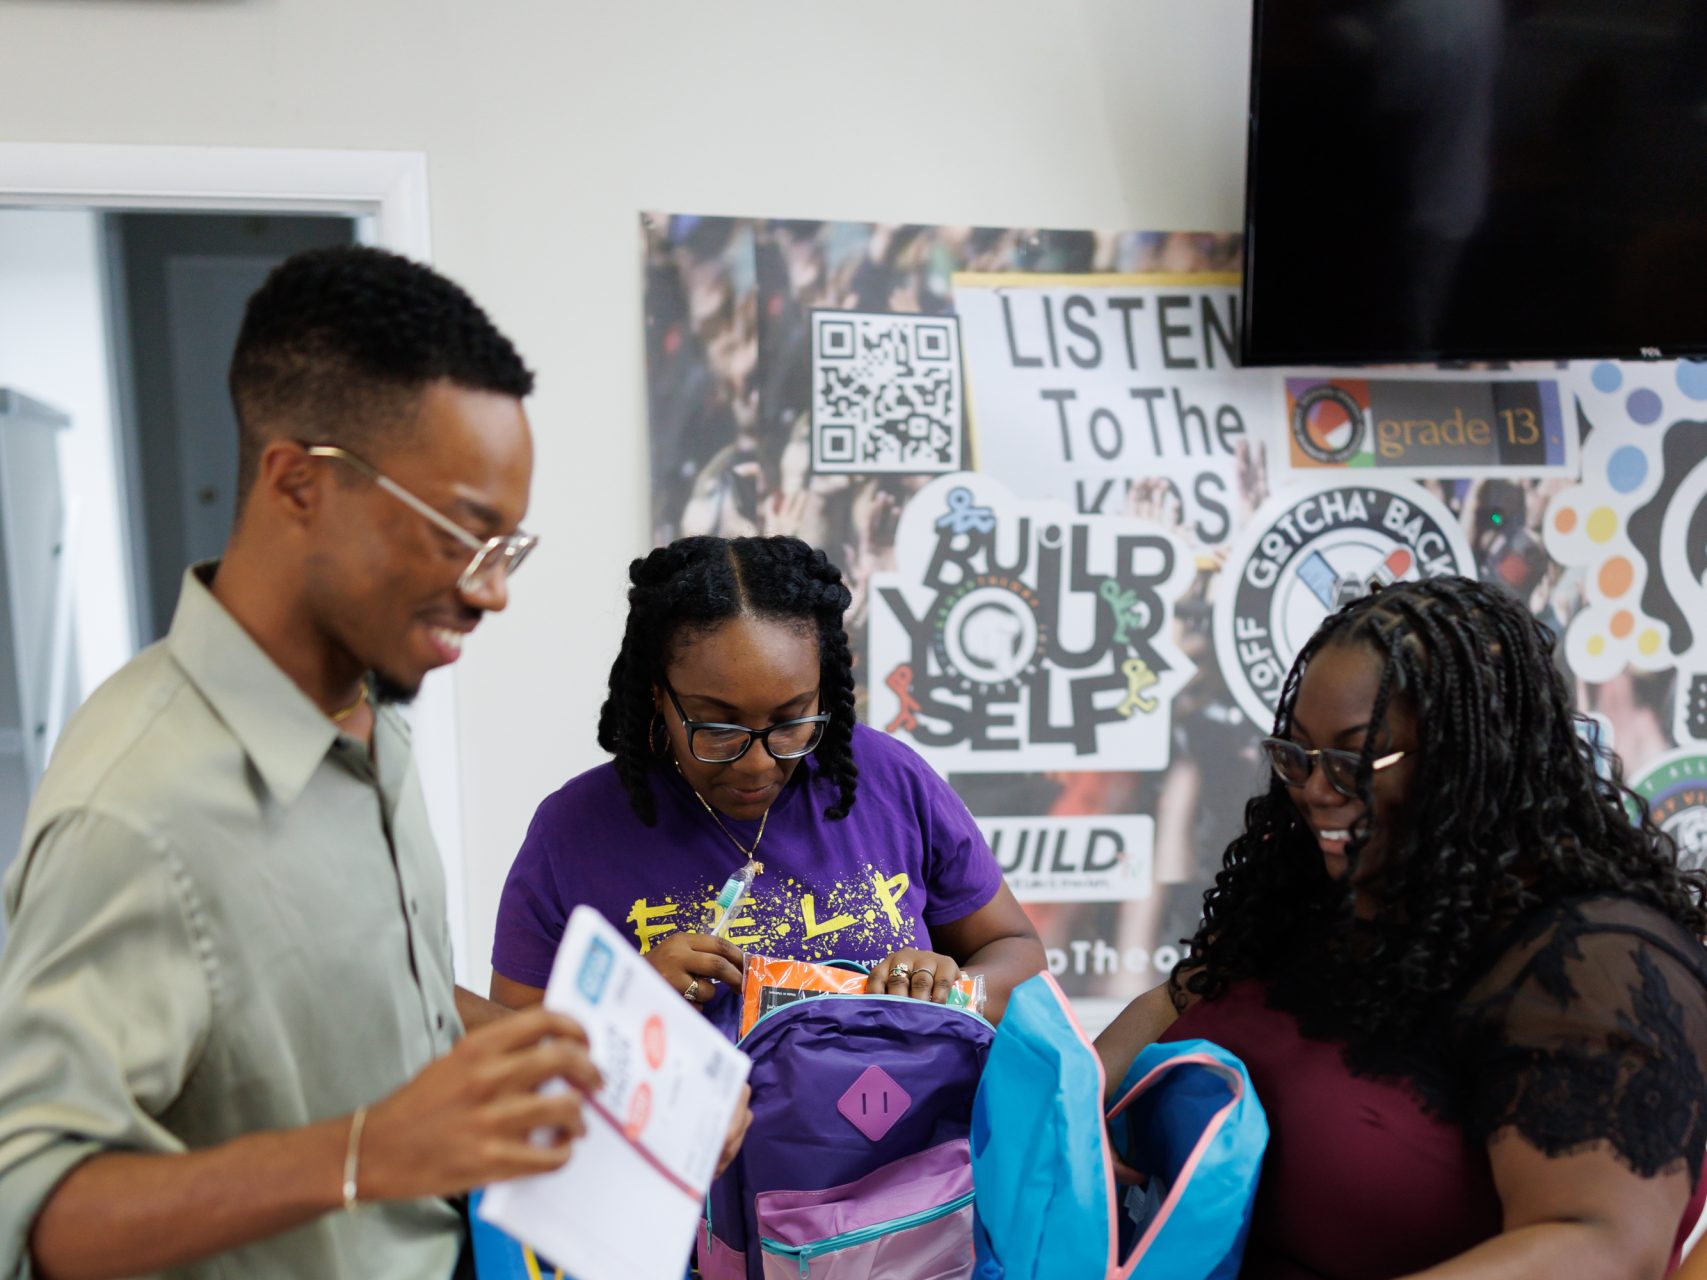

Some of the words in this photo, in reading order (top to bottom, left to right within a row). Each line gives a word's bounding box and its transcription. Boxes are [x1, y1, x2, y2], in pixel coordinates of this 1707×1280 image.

[1001, 294, 1243, 370] LISTEN
[1041, 388, 1124, 462] To
[1130, 386, 1245, 457] The
[1377, 406, 1493, 460] grade
[1500, 407, 1541, 446] 13
[1075, 471, 1232, 544] KS
[910, 672, 1130, 756] SELF
[991, 828, 1125, 874] UILD
